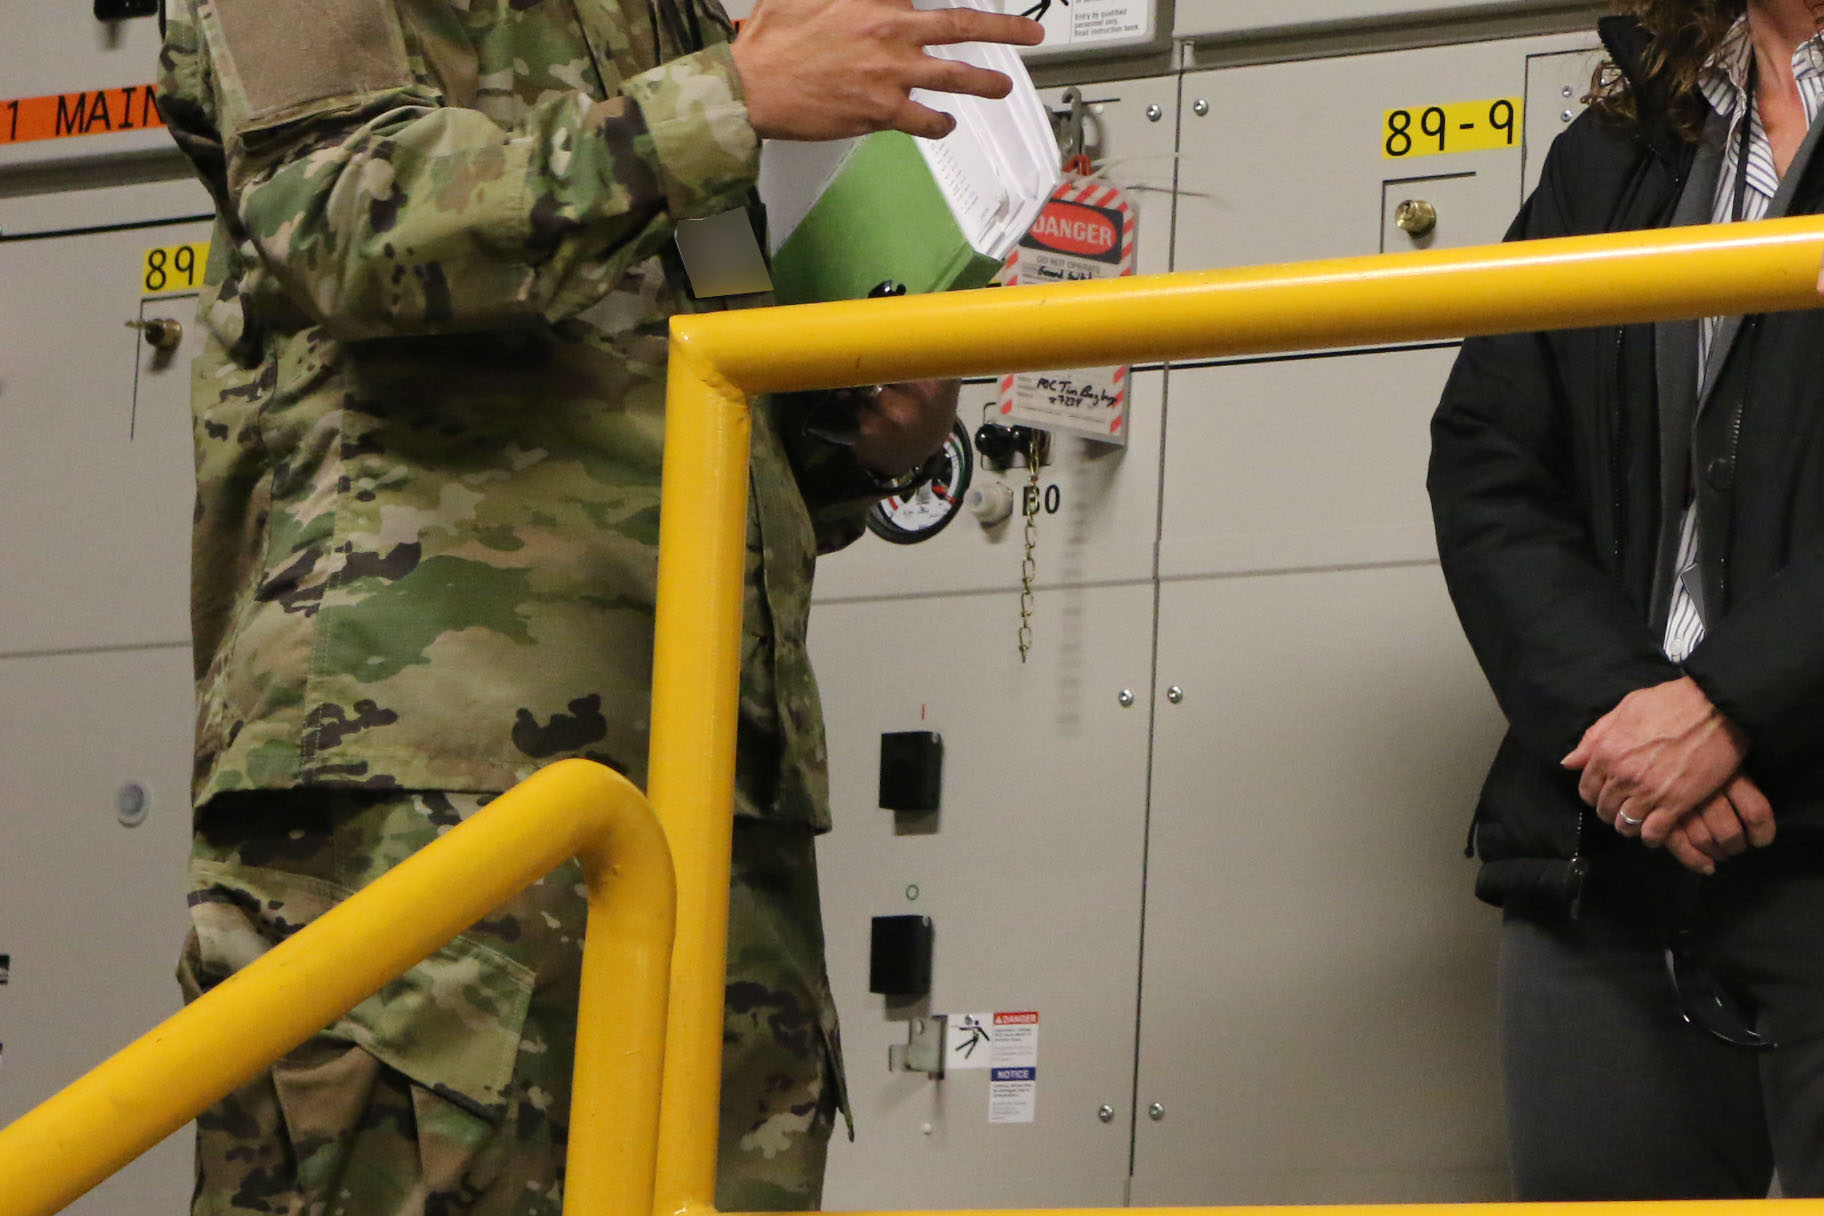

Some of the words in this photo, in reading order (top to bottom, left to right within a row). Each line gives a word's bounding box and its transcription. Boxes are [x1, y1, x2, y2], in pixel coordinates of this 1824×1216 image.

[7, 100, 20, 140] 1
[55, 85, 166, 136] MAIN
[1385, 99, 1514, 156] 89-9
[1032, 215, 1113, 248] DANGER
[145, 245, 195, 291] 89
[997, 1070, 1030, 1080] NOTICE
